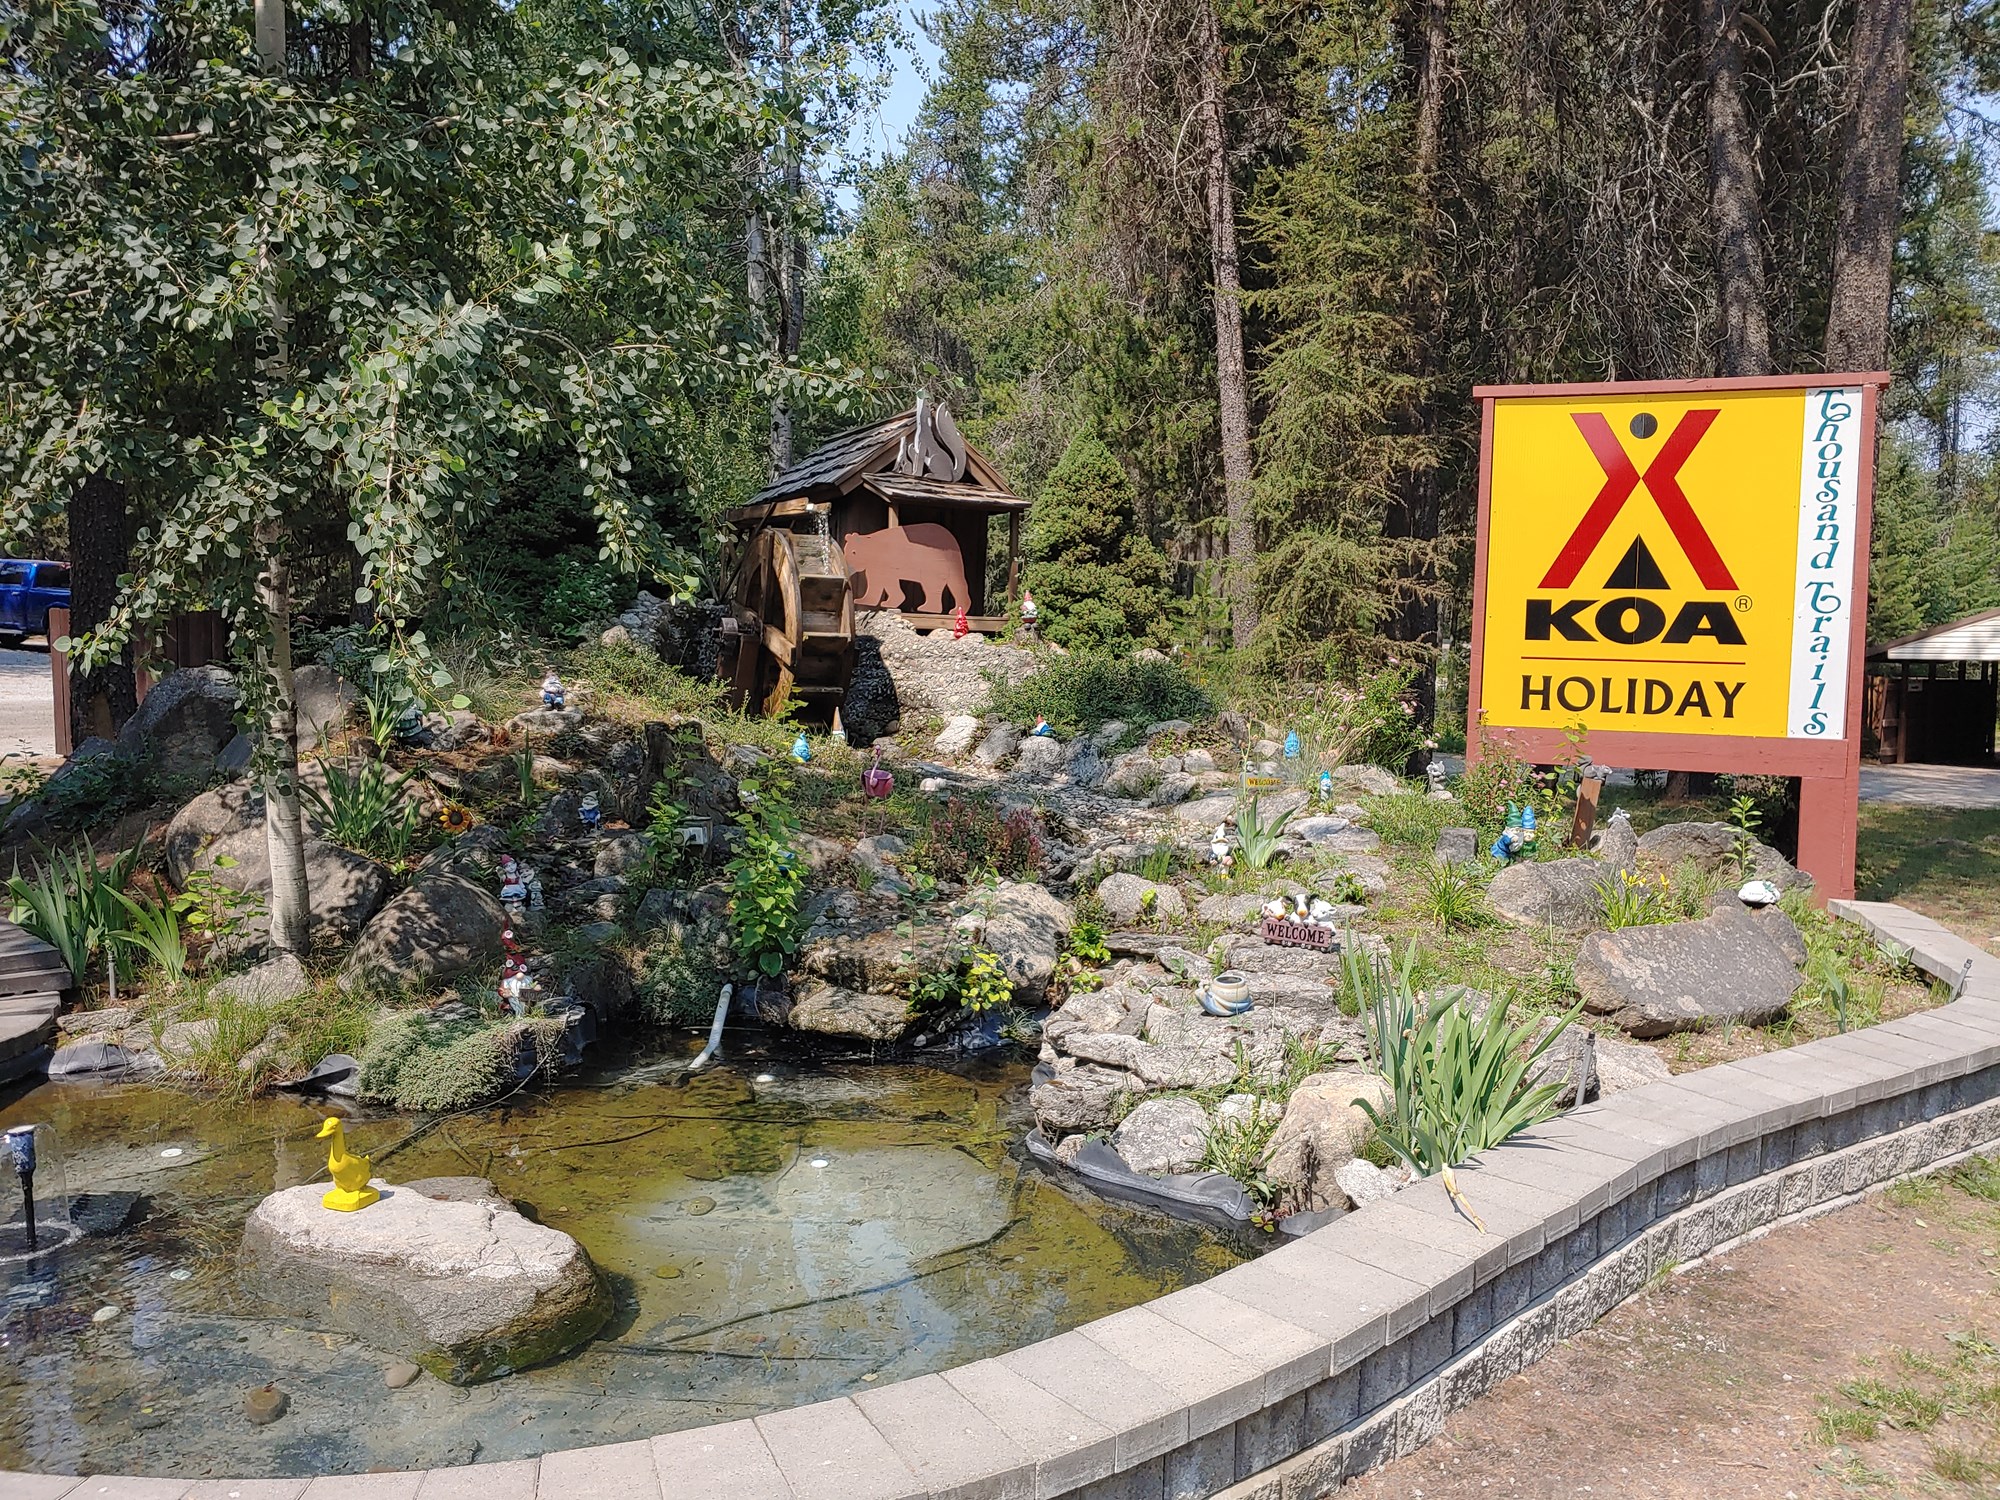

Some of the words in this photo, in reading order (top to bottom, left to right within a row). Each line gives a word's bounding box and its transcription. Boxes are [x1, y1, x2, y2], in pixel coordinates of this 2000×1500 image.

[1810, 389, 1851, 569] Thousand
[1525, 596, 1747, 645] KOA
[1804, 581, 1841, 735] Trails
[1520, 675, 1746, 718] HOLIDAY
[1266, 922, 1325, 944] WELCOME
